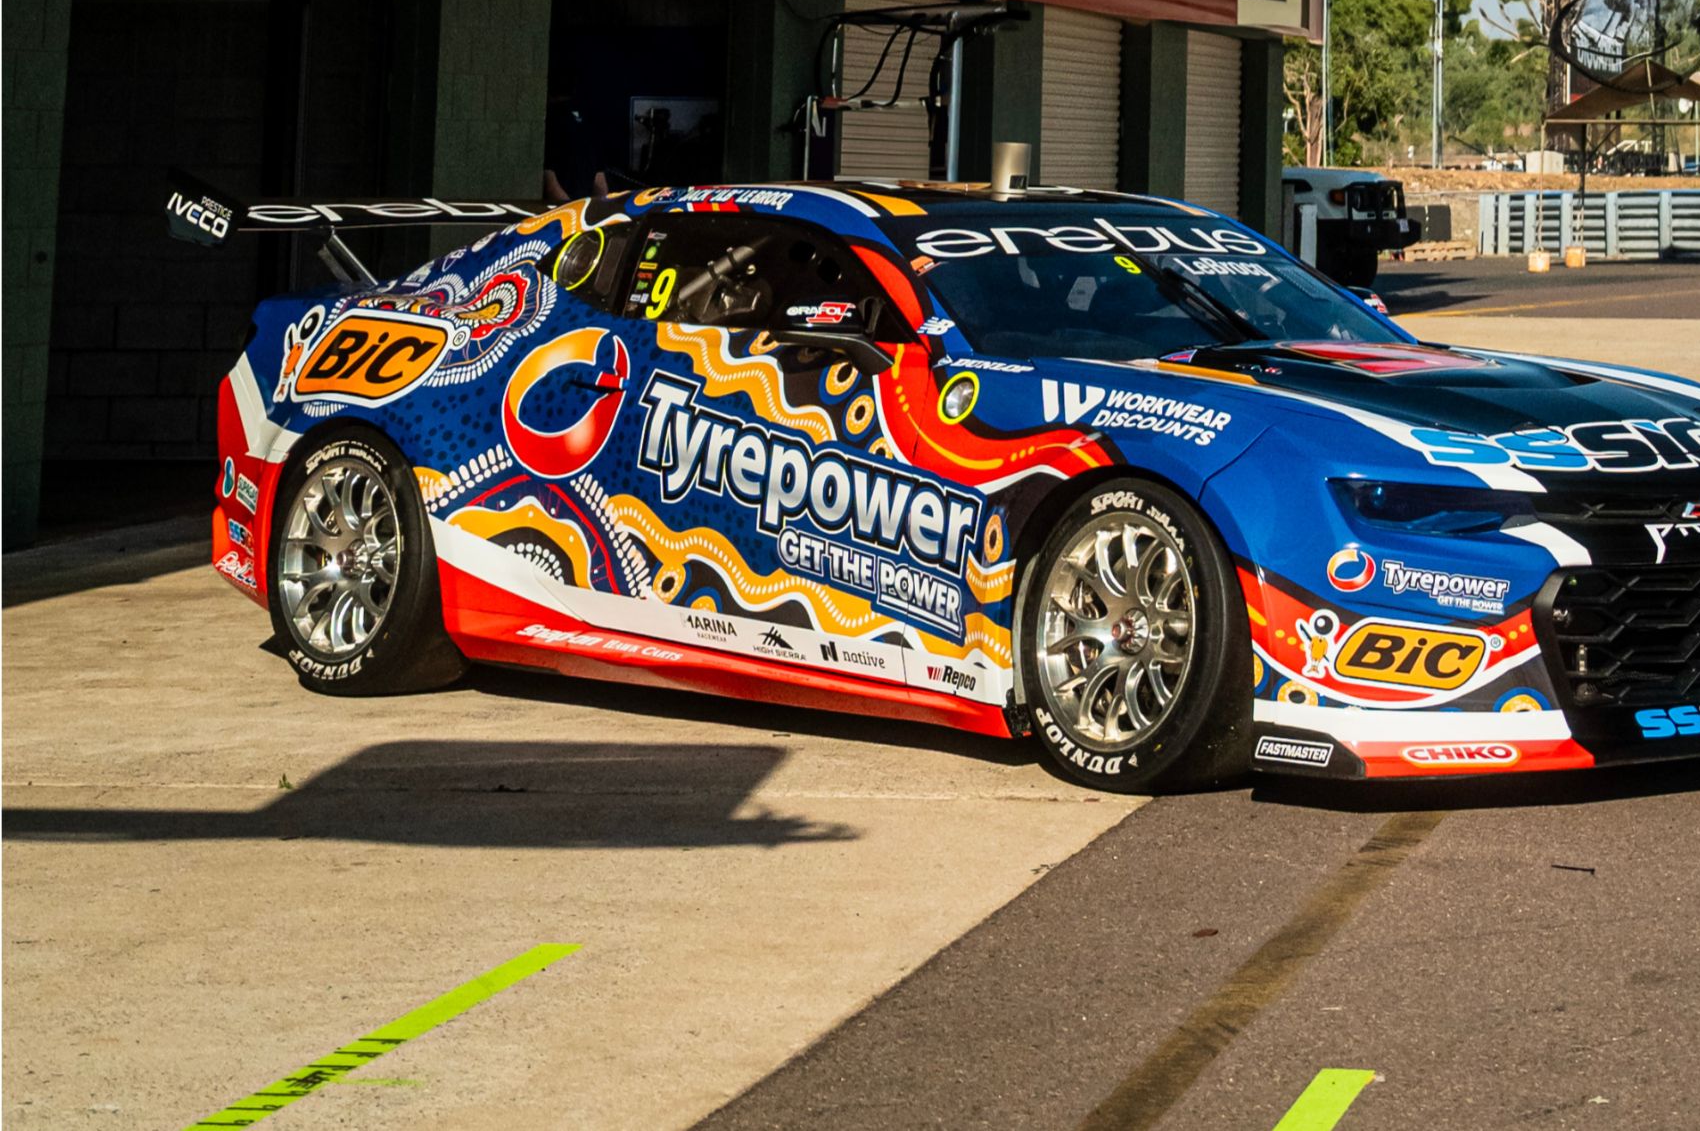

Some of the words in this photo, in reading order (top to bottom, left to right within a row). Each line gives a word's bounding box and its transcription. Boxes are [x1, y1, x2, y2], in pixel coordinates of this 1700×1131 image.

[167, 192, 229, 238] IVECO
[916, 218, 1267, 257] erebus
[1113, 256, 1141, 274] 9
[645, 268, 677, 319] 9
[951, 358, 1034, 373] DUNLOP
[1093, 409, 1217, 446] DISCOUNTS
[1106, 389, 1231, 431] WORKWEAR
[643, 375, 979, 573] Tyrepower
[779, 532, 829, 572] GET
[829, 548, 876, 588] THE
[878, 563, 962, 620] POWER
[1383, 561, 1509, 599] Tyrepower
[1437, 595, 1453, 606] GET
[1455, 598, 1471, 608] THE
[516, 624, 604, 646] Snap-on
[842, 650, 885, 669] natiive
[942, 665, 977, 691] Repco
[1036, 706, 1125, 776] DUNLOP
[1260, 741, 1329, 761] FASTMASTER
[1408, 745, 1513, 761] CHIKO
